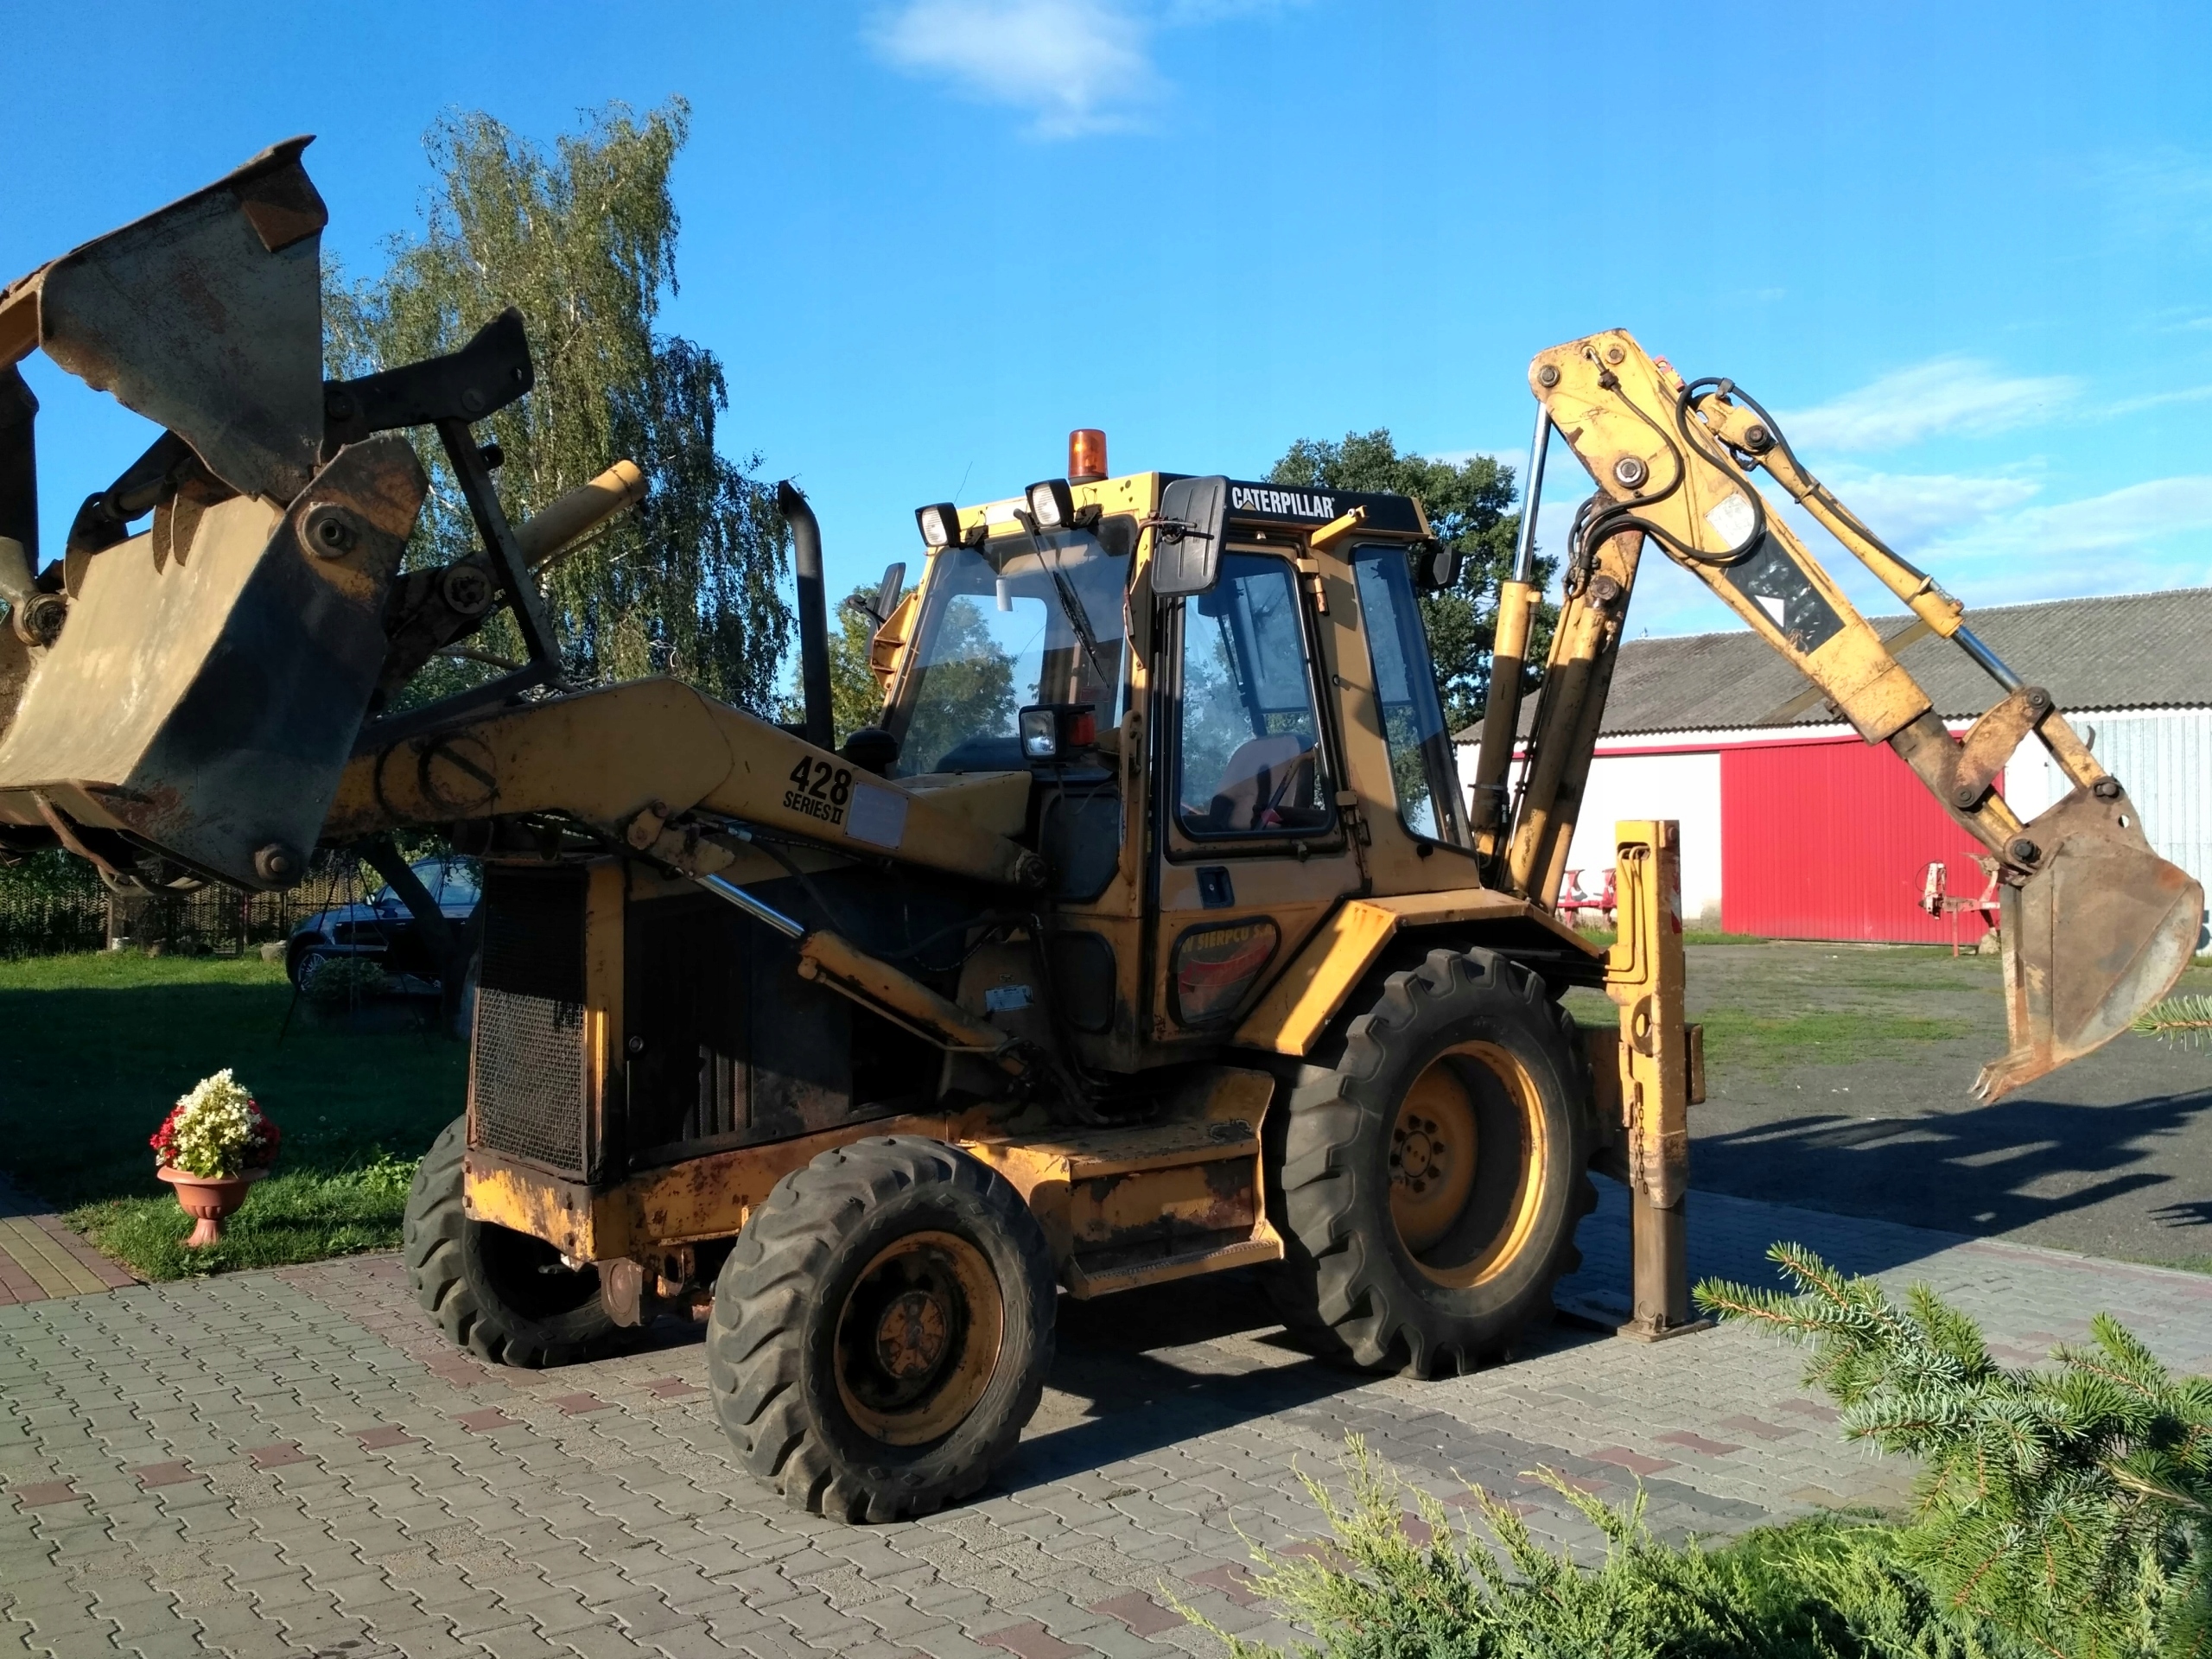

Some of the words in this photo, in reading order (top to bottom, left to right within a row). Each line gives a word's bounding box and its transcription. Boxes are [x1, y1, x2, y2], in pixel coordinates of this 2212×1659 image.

[1232, 486, 1335, 518] CATERPILLAR
[790, 755, 852, 805] 428
[783, 791, 831, 821] SERIES
[830, 806, 844, 825] II
